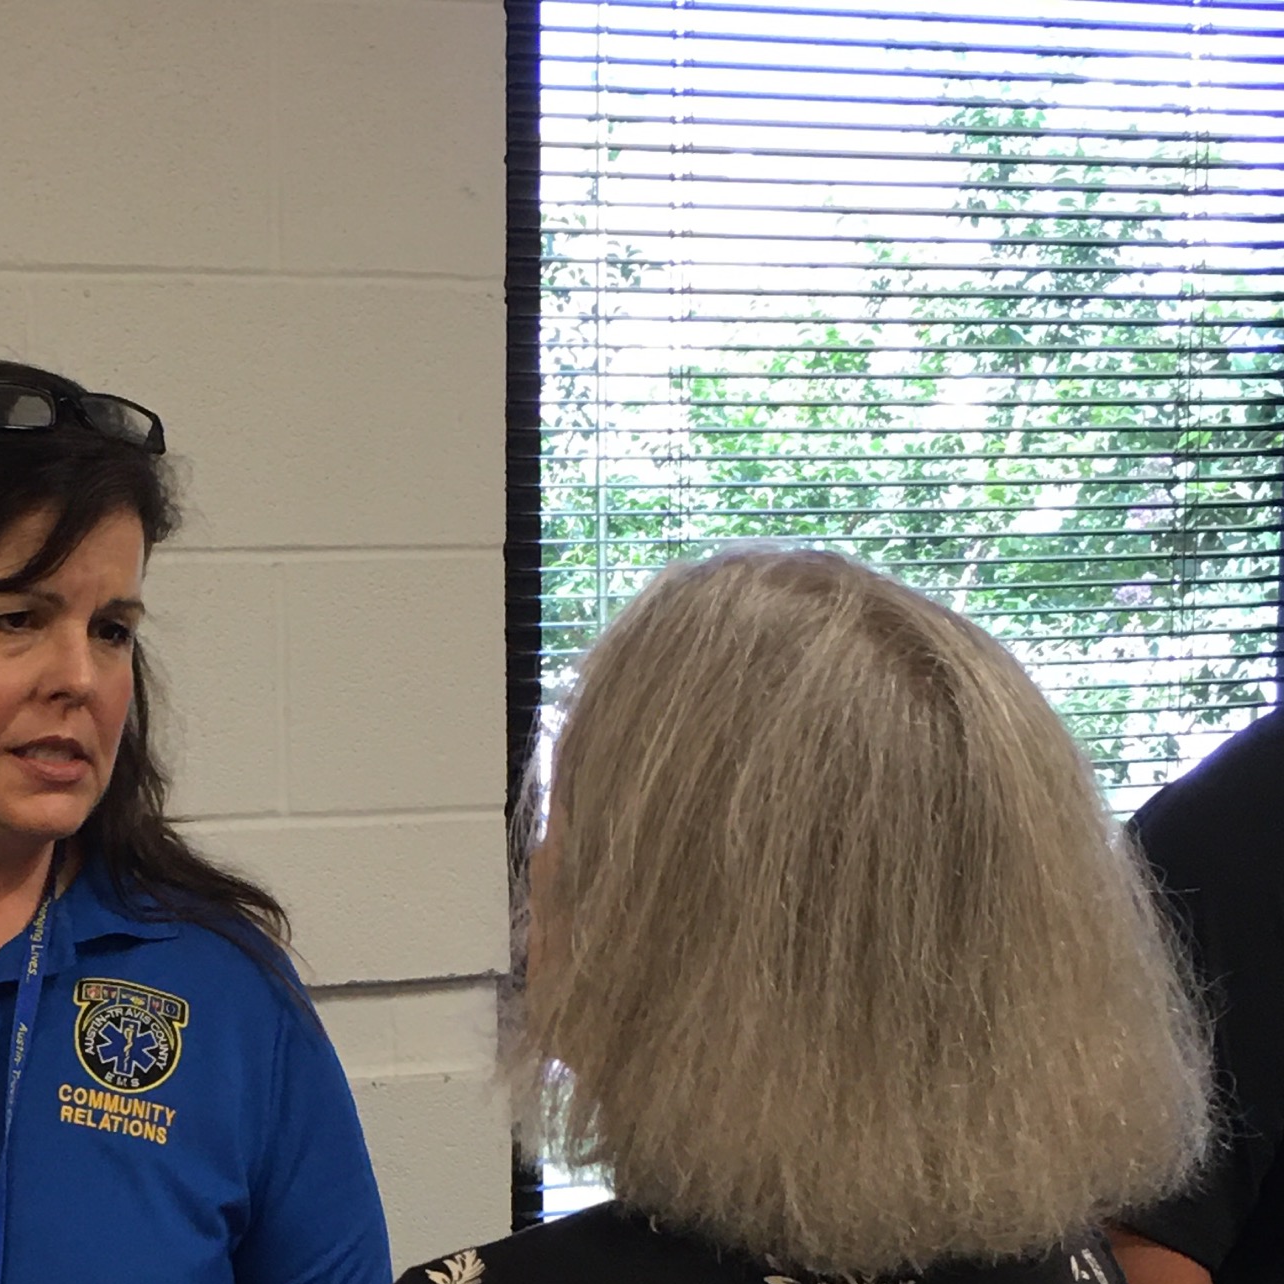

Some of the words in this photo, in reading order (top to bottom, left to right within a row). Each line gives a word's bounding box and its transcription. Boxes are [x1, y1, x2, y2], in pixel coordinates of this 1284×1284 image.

[150, 1023, 170, 1071] COUNTY
[104, 1071, 141, 1088] EMS
[58, 1083, 176, 1127] COMMUNITY
[59, 1104, 168, 1145] RELATIONS
